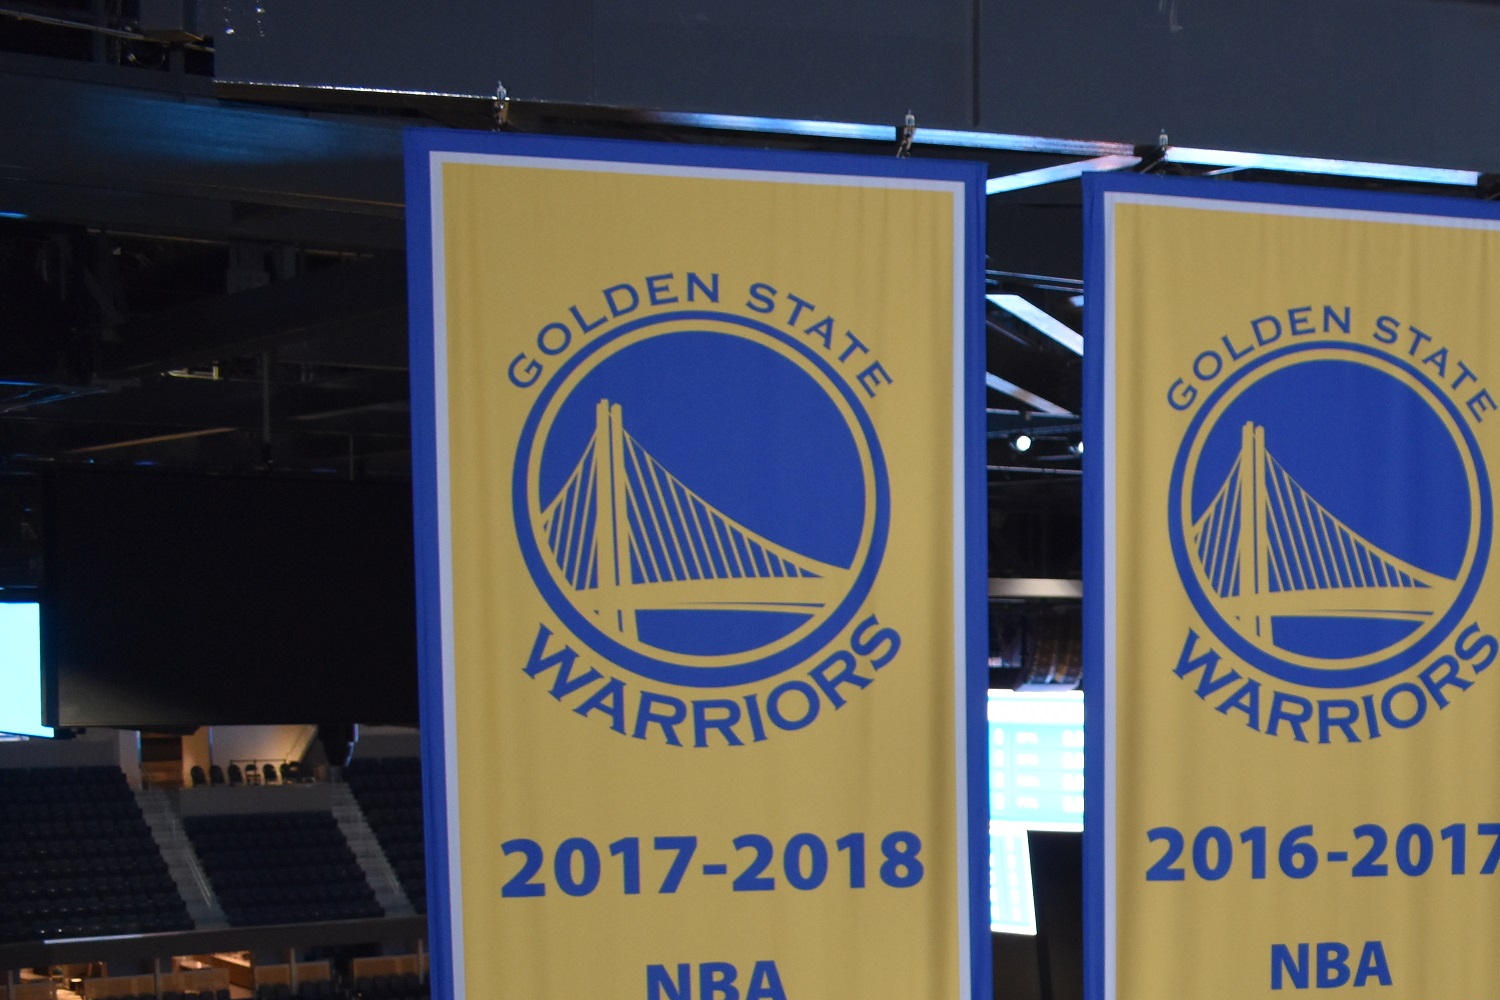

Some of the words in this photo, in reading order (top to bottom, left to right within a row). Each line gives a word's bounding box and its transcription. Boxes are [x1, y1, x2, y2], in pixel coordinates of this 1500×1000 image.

[507, 272, 720, 390] GOLDEN
[745, 282, 894, 399] STATE
[1166, 305, 1352, 412] GOLDEN
[1372, 314, 1499, 424] STATE
[521, 612, 903, 749] WARRIORS
[1171, 620, 1500, 745] WARRIORS
[500, 830, 925, 898] 2017-2018
[1271, 941, 1392, 990] NBA
